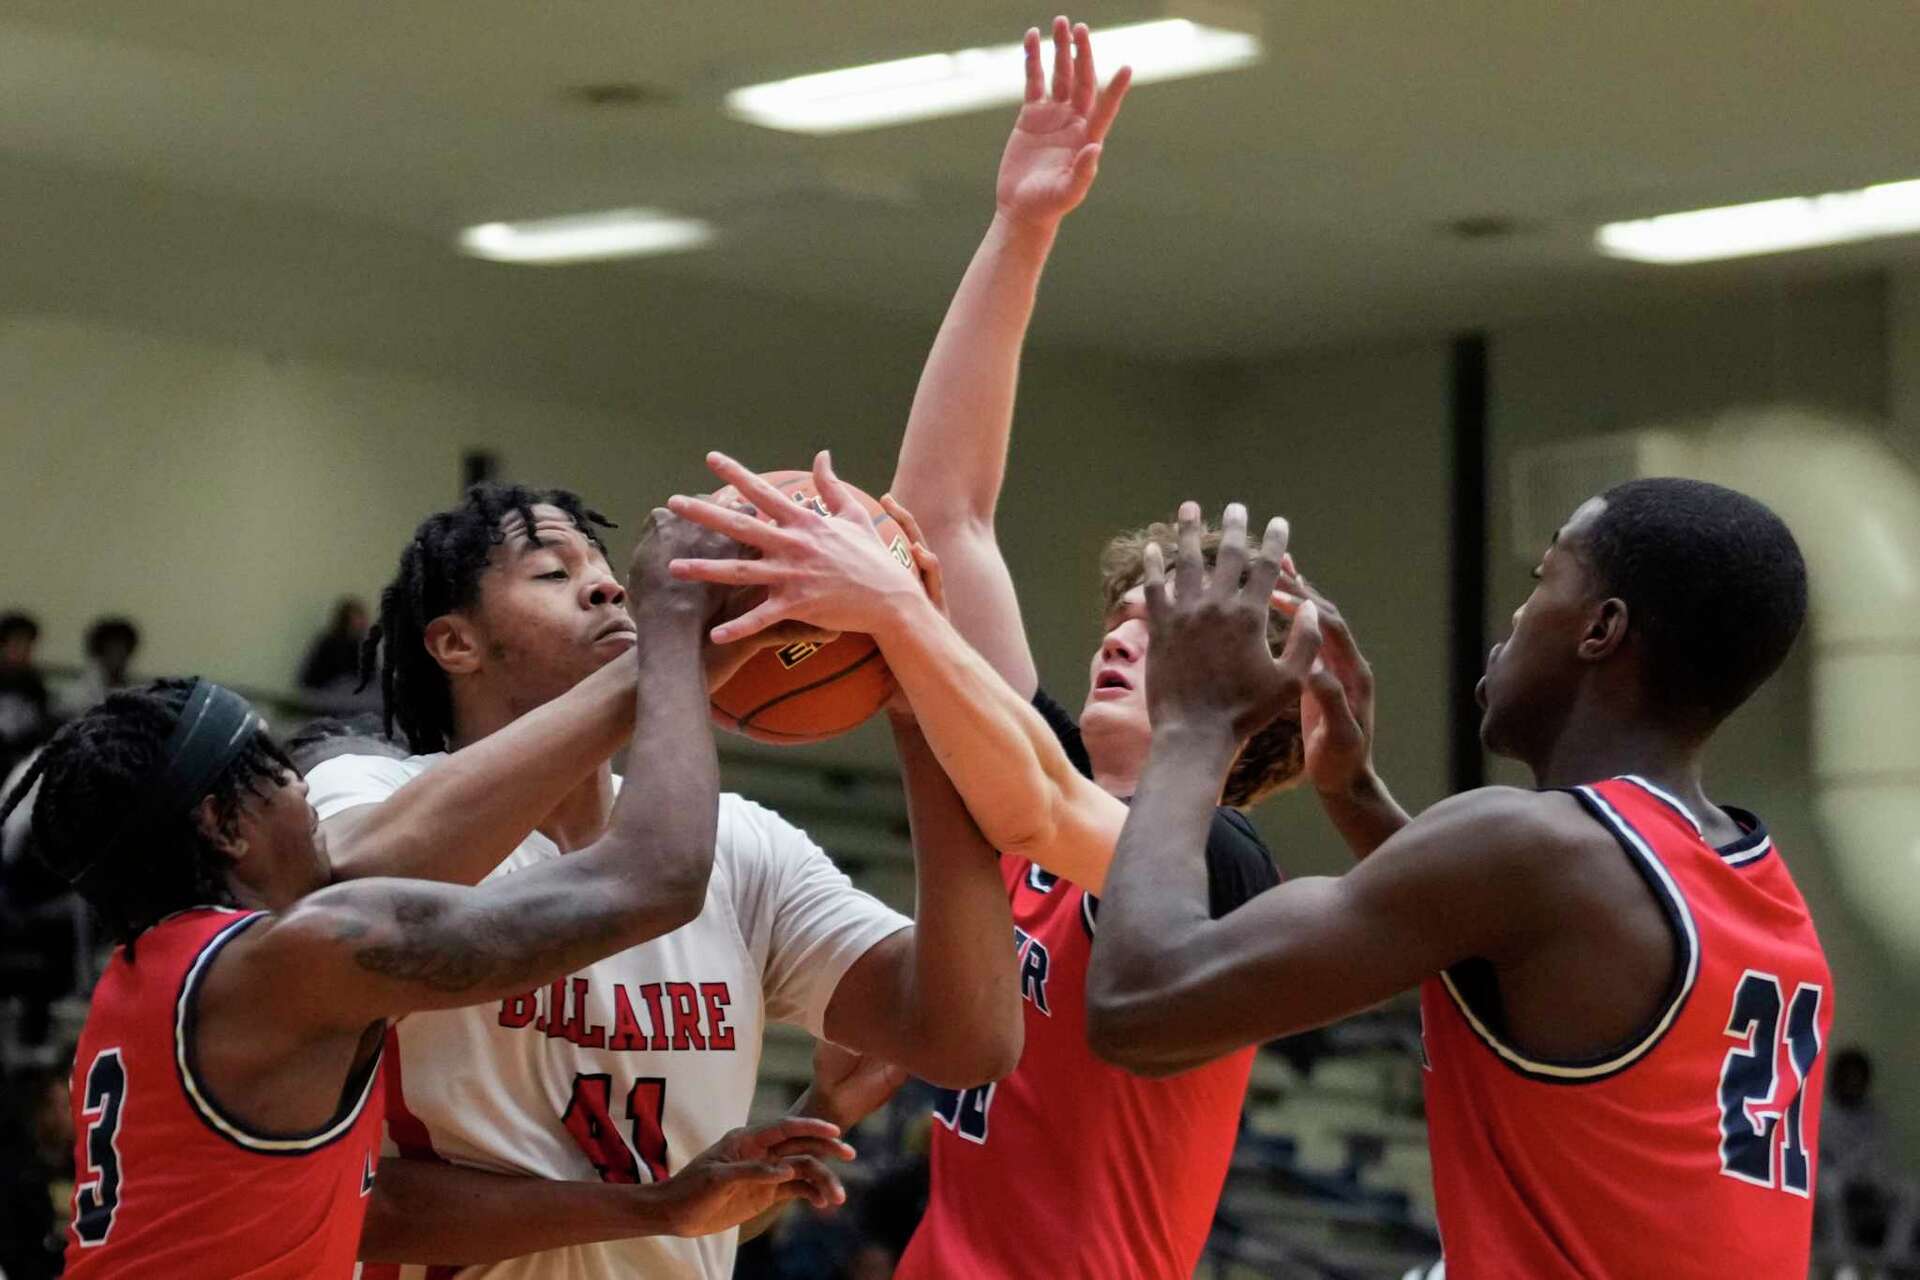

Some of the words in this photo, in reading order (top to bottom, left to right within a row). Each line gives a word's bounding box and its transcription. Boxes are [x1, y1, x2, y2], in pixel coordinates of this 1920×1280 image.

[498, 975, 736, 1050] BLLAIRE
[1716, 969, 1823, 1199] 21
[71, 1047, 127, 1247] 3
[561, 1072, 670, 1184] 41
